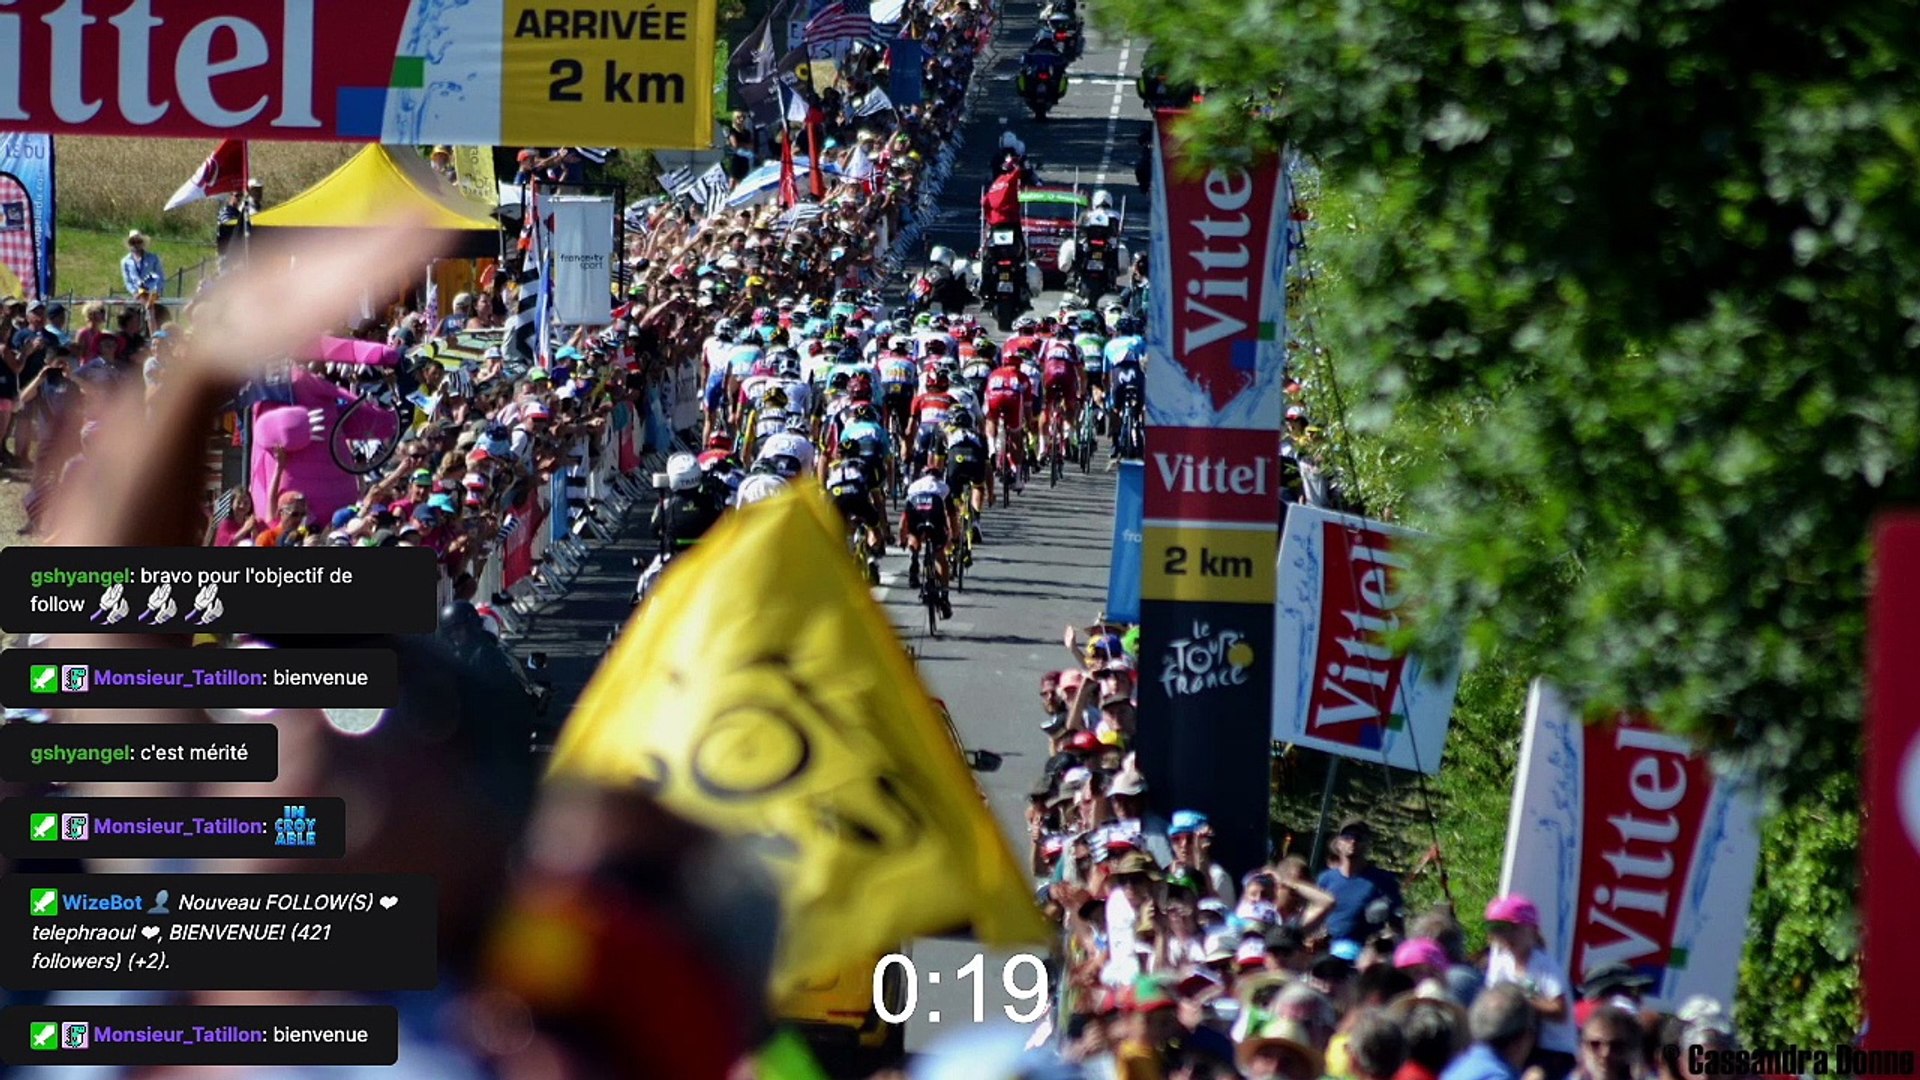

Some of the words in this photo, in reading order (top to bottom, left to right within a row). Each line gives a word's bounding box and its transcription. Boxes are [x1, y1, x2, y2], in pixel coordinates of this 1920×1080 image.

[514, 4, 687, 41] ARRIVÉE
[547, 59, 583, 103] 2
[604, 60, 685, 104] km
[1153, 452, 1268, 496] Vittel
[1163, 546, 1188, 575] 2
[1200, 547, 1253, 578] km
[1314, 544, 1411, 728] Vittel
[1581, 726, 1692, 977] Vittel
